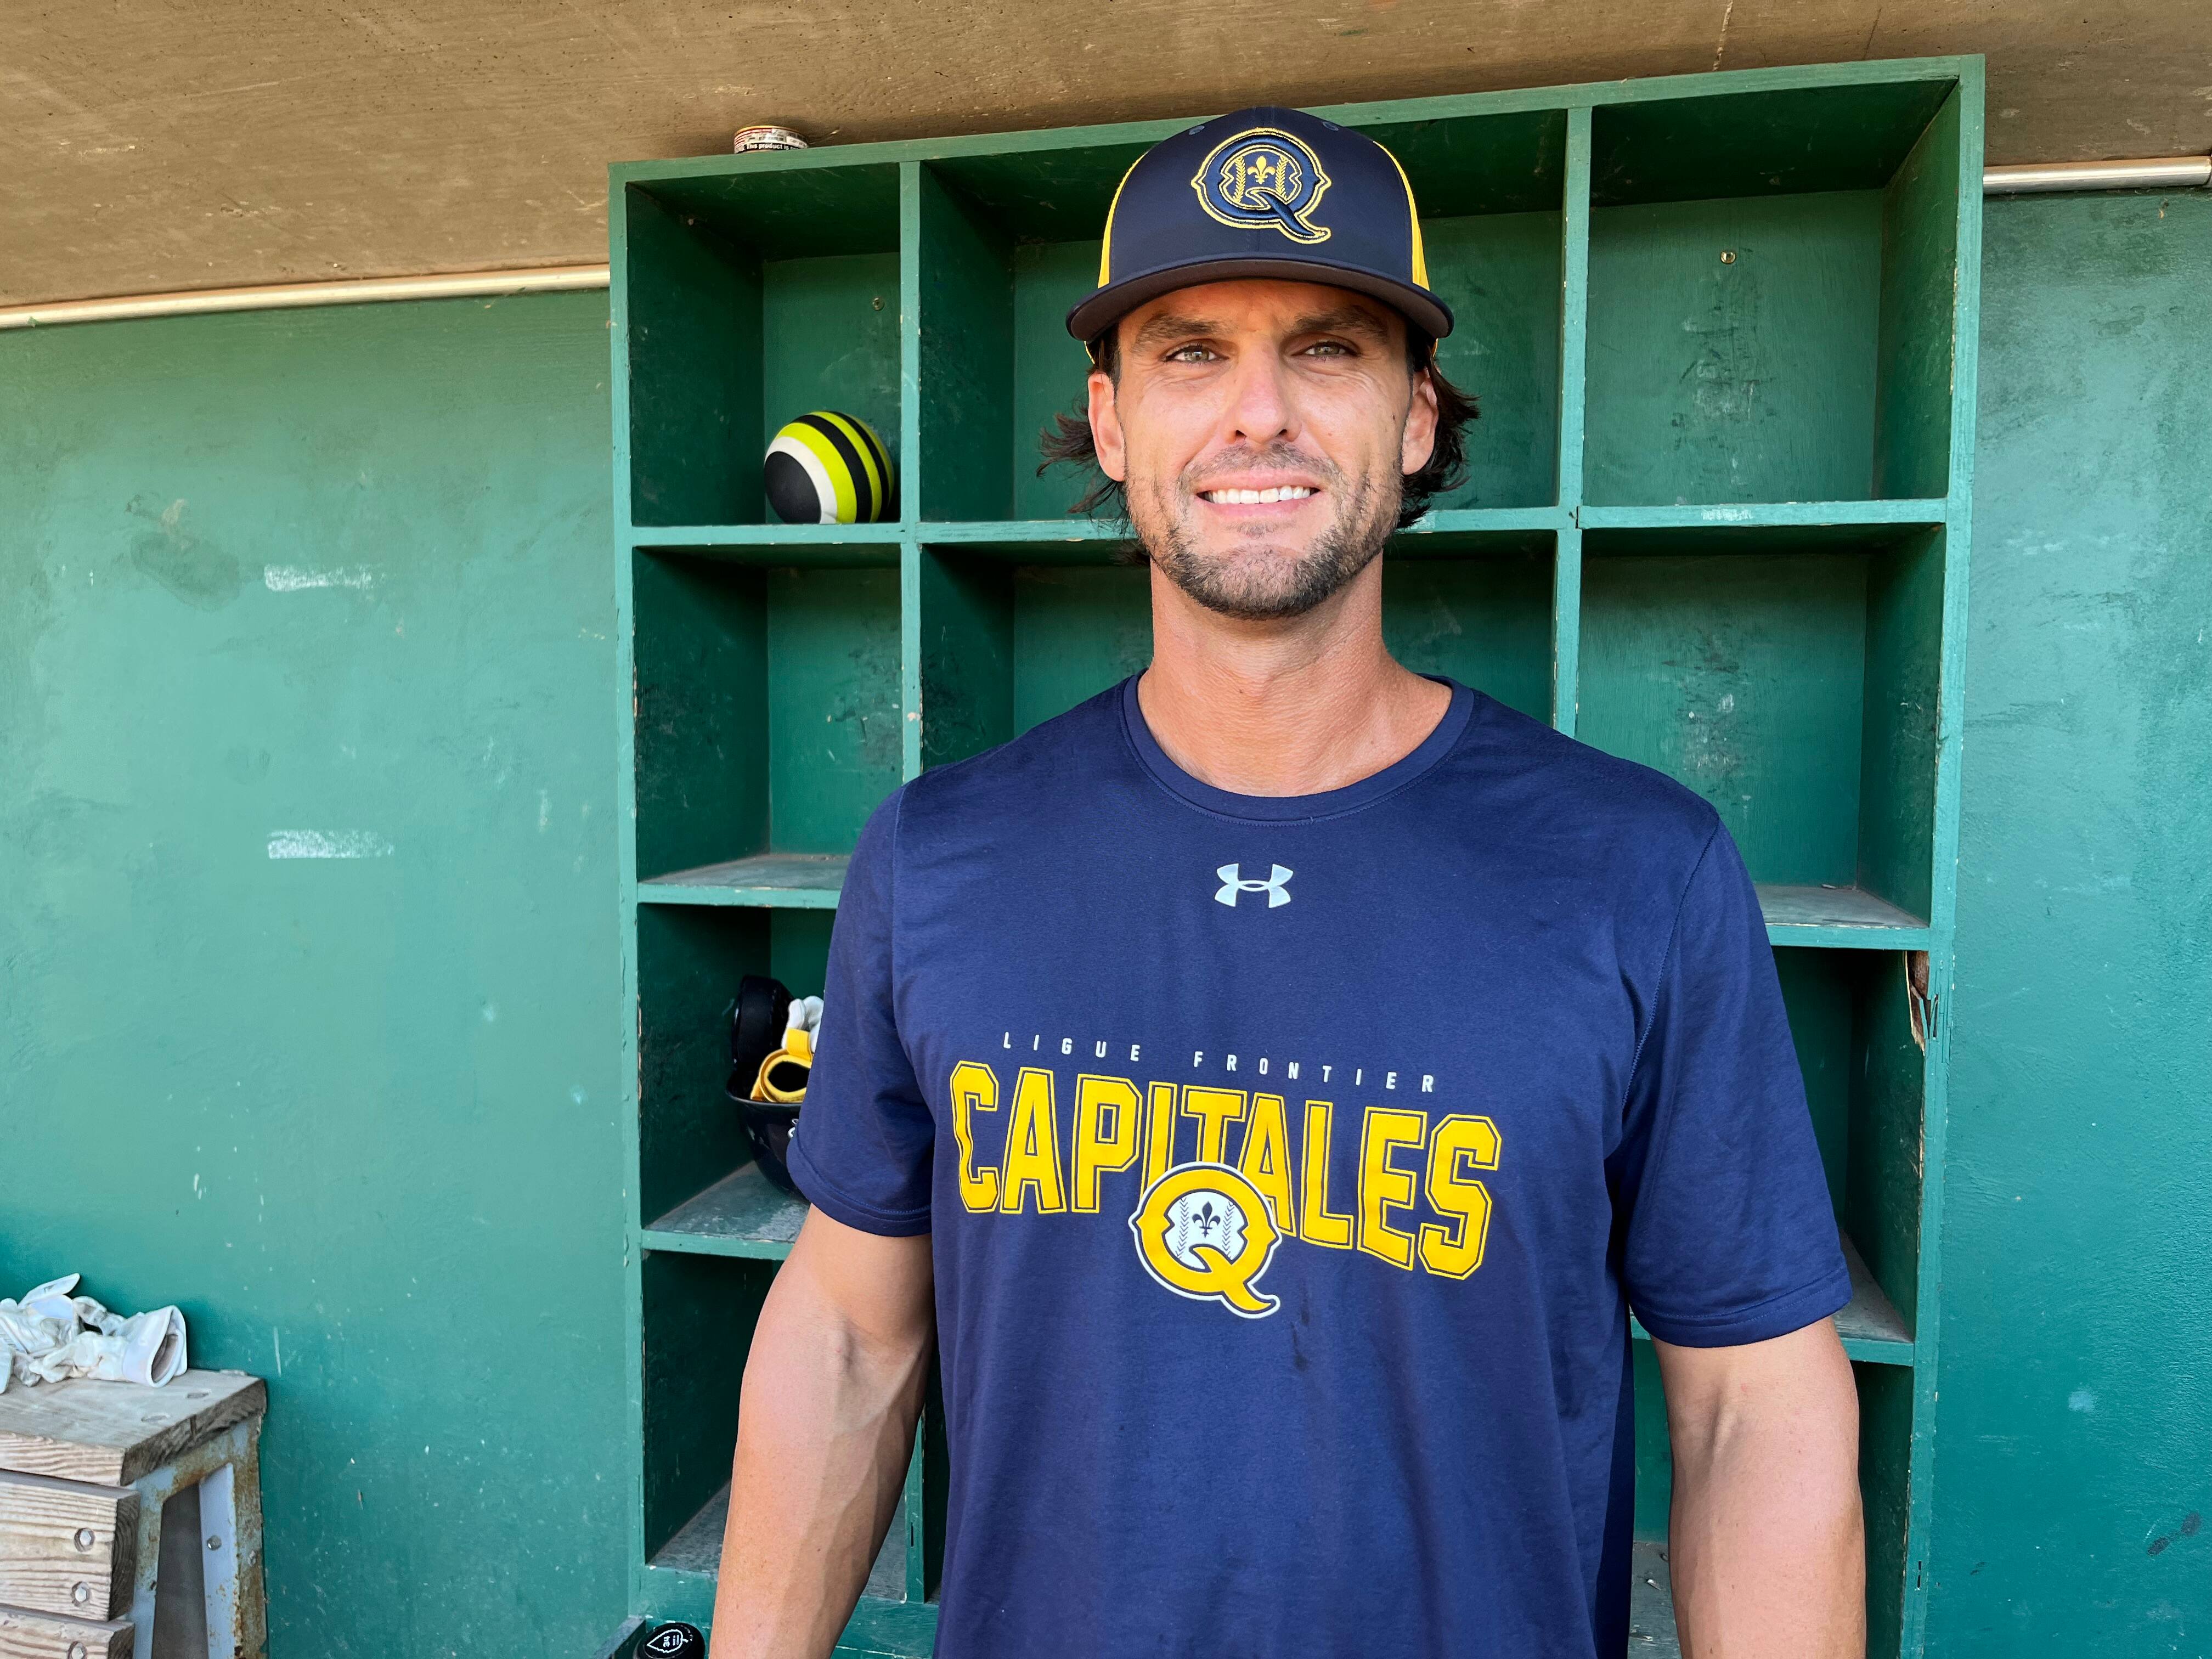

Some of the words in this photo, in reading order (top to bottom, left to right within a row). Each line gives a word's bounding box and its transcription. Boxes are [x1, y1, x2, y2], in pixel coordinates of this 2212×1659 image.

[1190, 127, 1332, 245] Q
[1003, 1031, 1141, 1063] LIGUE
[1193, 1050, 1435, 1093] FRONTIER
[949, 1060, 1502, 1280] CAPITALES
[1127, 1160, 1283, 1320] Q
